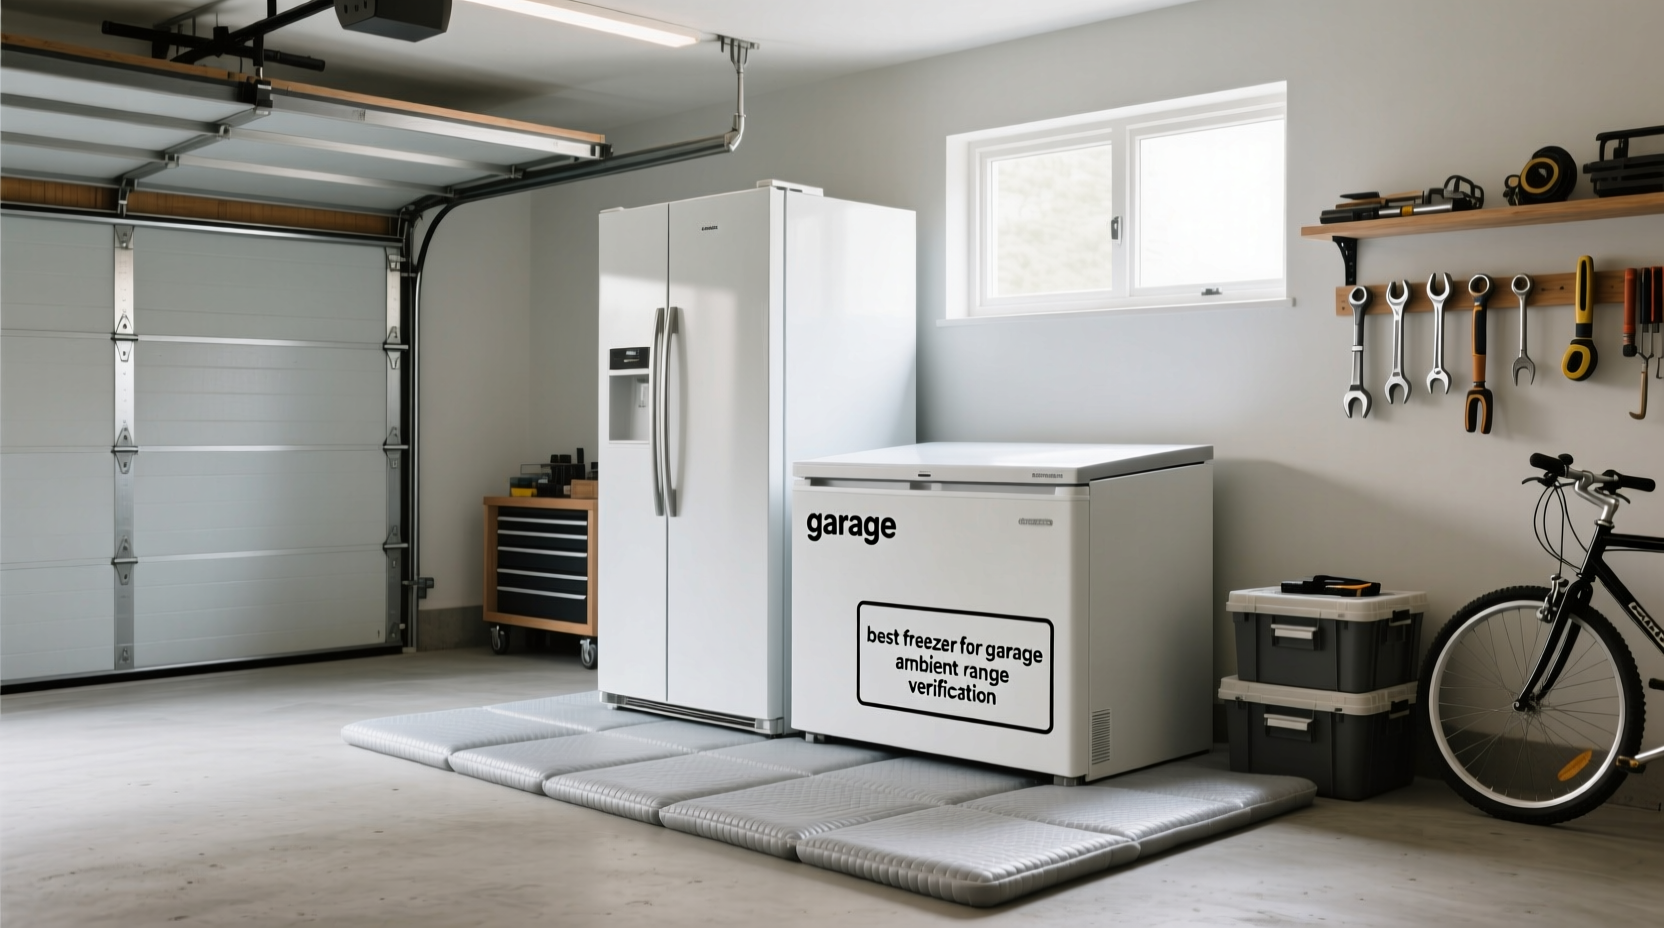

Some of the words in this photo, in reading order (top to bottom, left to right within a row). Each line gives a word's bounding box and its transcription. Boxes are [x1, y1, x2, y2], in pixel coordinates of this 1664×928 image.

[807, 513, 896, 545] garage
[867, 625, 900, 646] best
[902, 628, 958, 654] freezer
[959, 636, 984, 656] for
[985, 643, 1044, 667] garage
[895, 654, 959, 677] ambient
[963, 665, 1010, 686] range
[908, 679, 997, 706] verification
